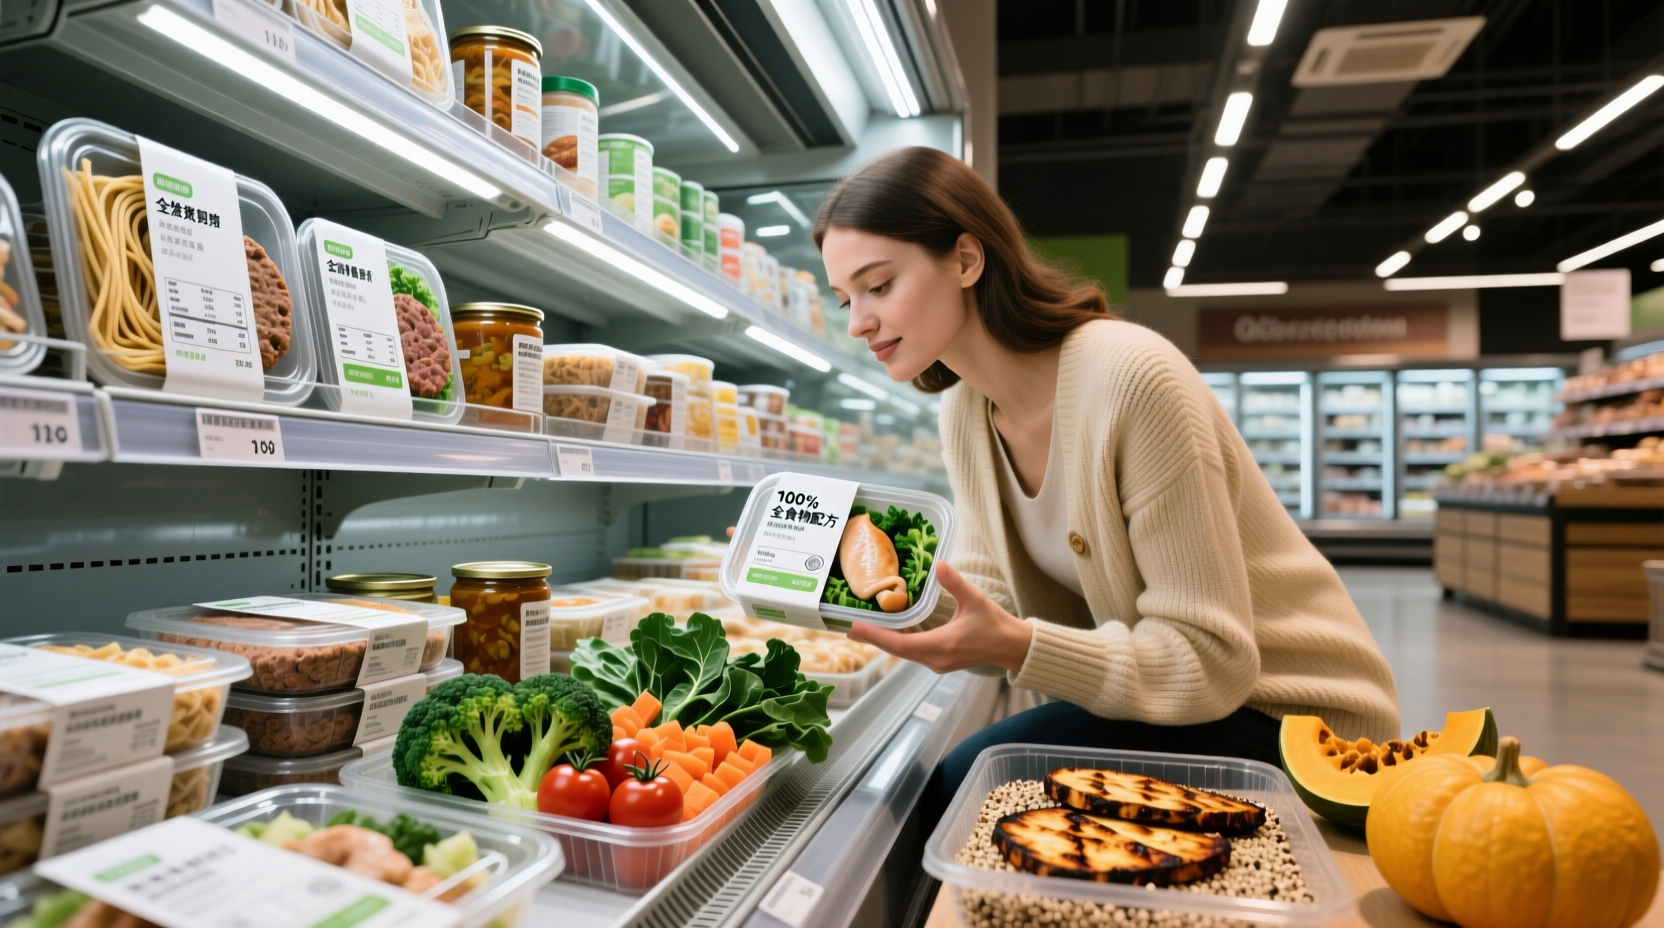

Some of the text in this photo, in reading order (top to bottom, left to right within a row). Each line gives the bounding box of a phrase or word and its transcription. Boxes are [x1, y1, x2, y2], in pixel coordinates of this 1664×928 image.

[777, 490, 819, 509] 100%
[769, 505, 840, 528] 全食物配方
